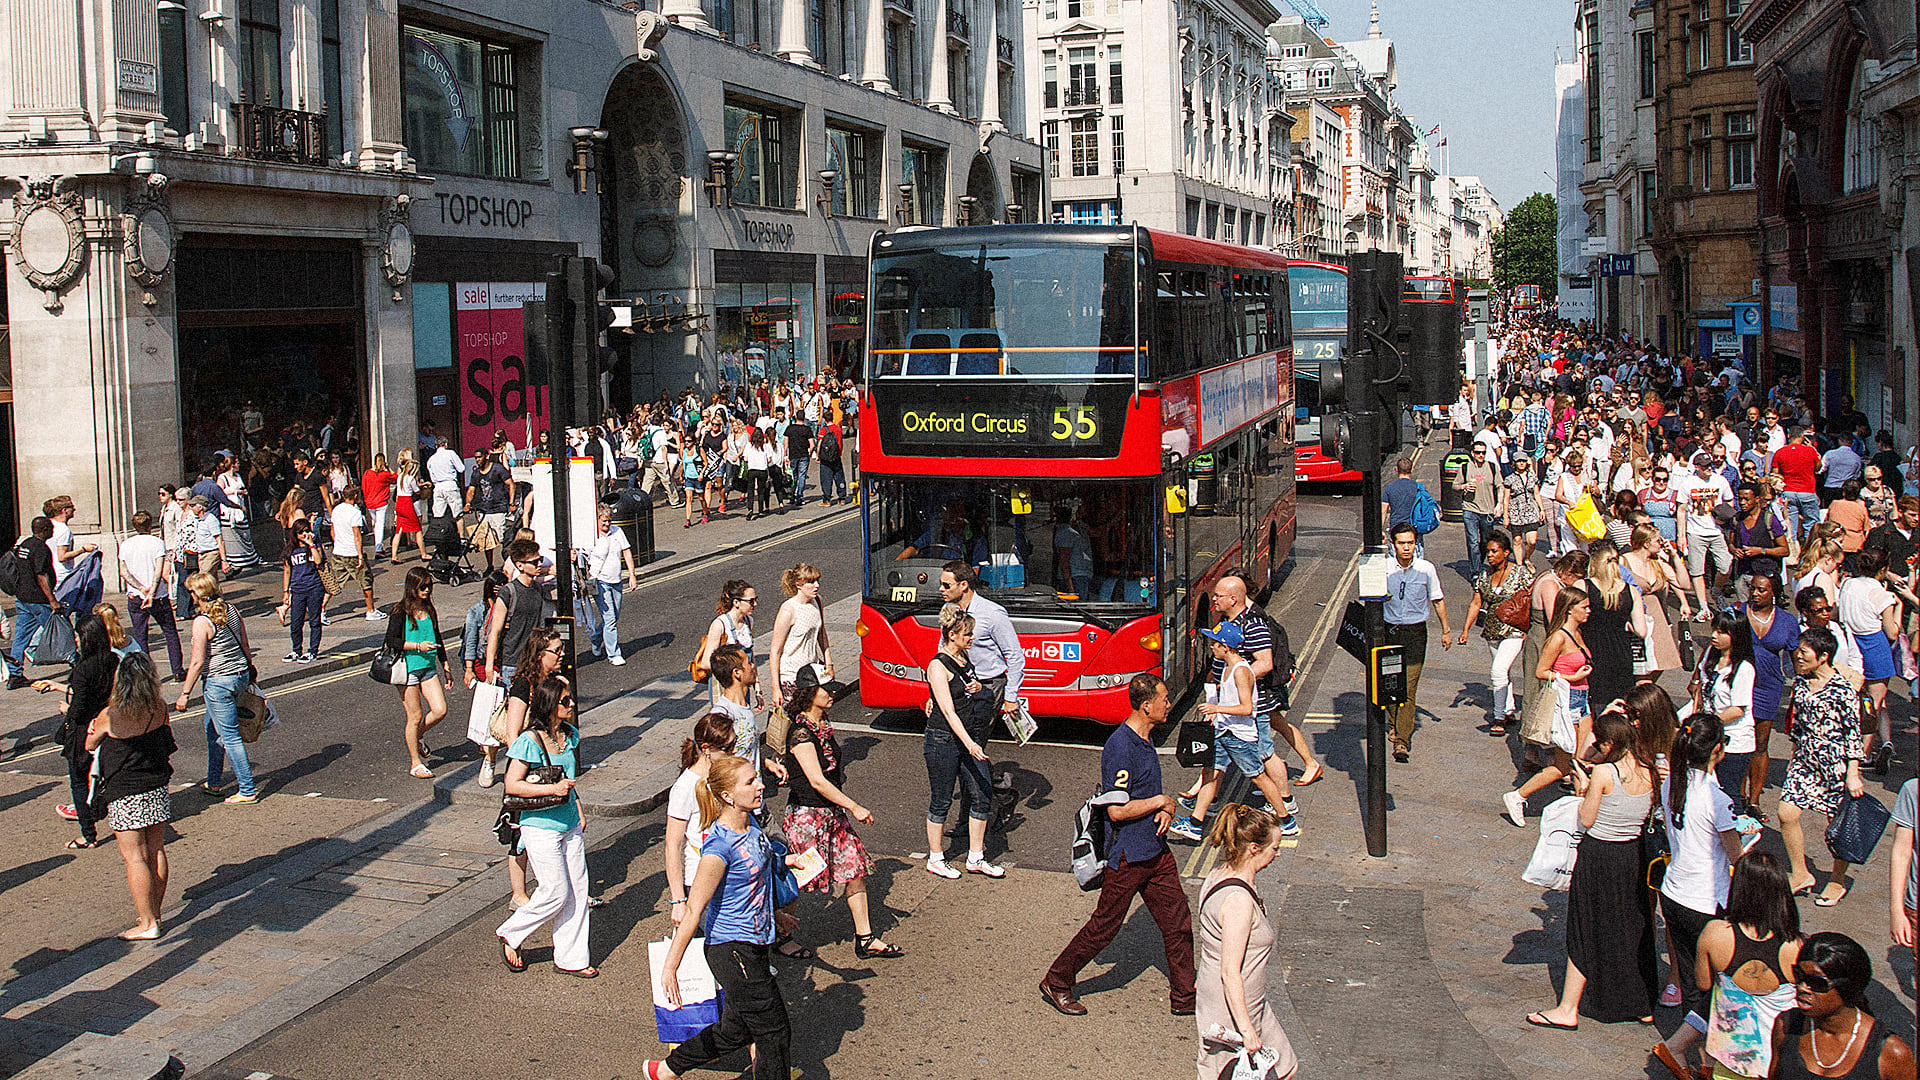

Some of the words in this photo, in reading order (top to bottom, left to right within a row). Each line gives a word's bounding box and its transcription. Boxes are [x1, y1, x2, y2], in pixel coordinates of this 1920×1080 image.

[421, 48, 463, 120] TOPSHOP
[434, 192, 533, 229] TOPSHOP
[741, 219, 794, 246] TOPSHOP
[1615, 259, 1631, 271] GAP
[463, 286, 488, 304] sale
[494, 292, 515, 304] further
[515, 292, 544, 303] reductons
[463, 331, 508, 348] TOPSHOP
[1716, 333, 1738, 343] CASH
[1313, 342, 1337, 359] 25
[902, 411, 966, 434] Oxford
[971, 412, 1028, 434] Circus
[1051, 405, 1098, 441] 55
[895, 591, 913, 603] 130
[1113, 769, 1130, 789] 2
